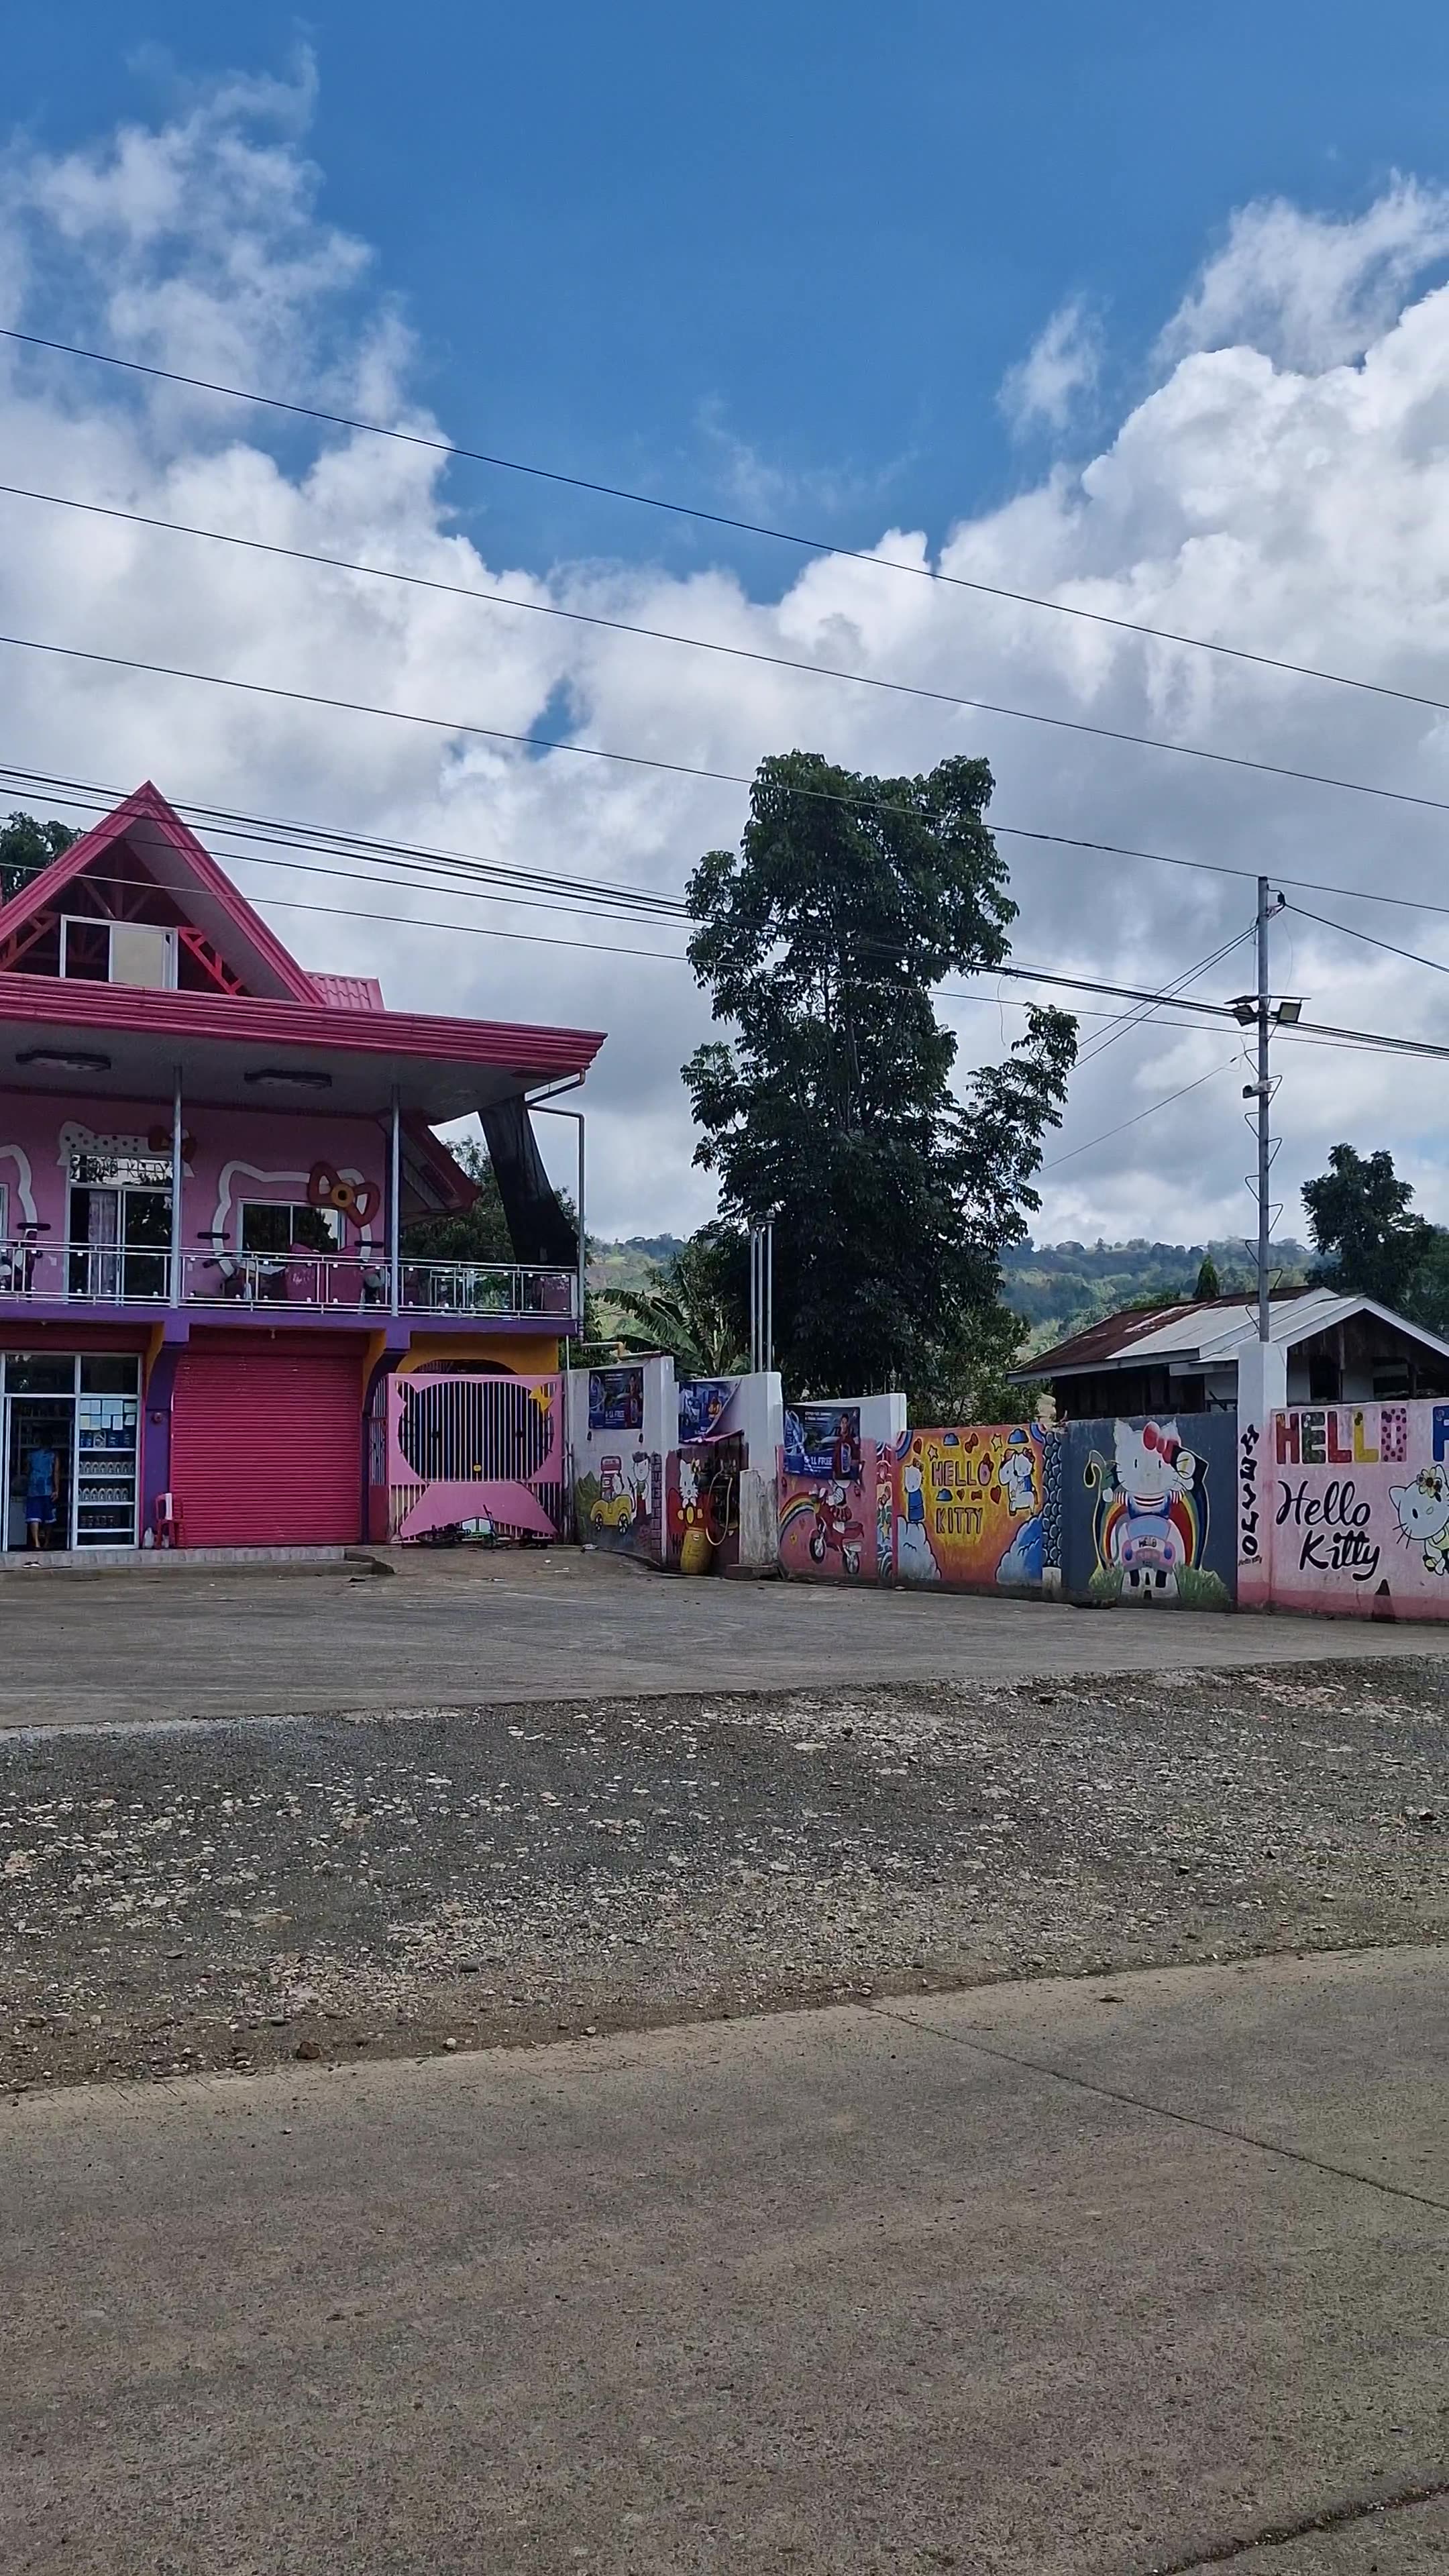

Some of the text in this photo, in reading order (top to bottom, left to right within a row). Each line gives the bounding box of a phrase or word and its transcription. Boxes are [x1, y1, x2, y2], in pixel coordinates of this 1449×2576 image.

[1276, 1408, 1407, 1464] HELLO
[932, 1460, 992, 1486] HELLO
[936, 1507, 983, 1535] KITTY
[1276, 1480, 1371, 1527] Hello
[1299, 1529, 1381, 1582] Kitty
